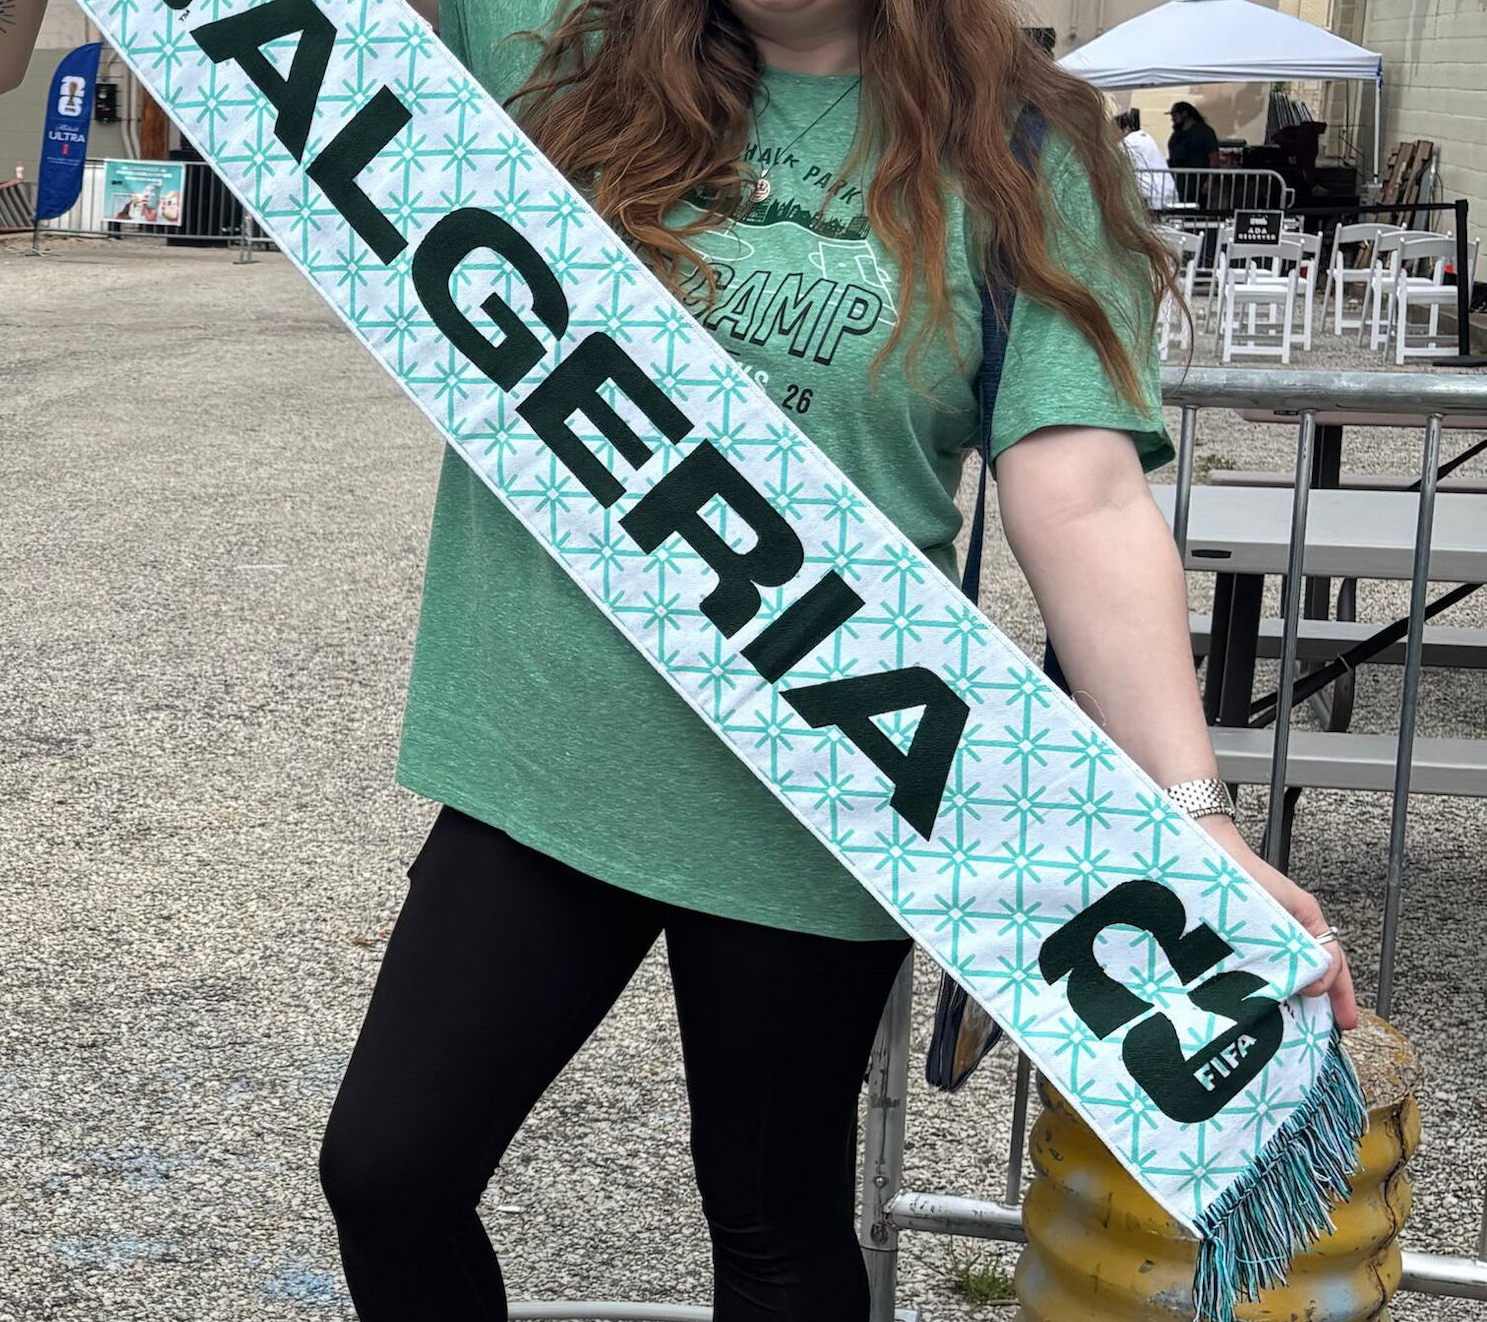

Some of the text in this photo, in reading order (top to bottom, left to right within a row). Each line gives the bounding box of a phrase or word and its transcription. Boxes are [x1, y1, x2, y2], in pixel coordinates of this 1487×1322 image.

[49, 131, 85, 142] ULTRA
[743, 142, 863, 206] HALK PARK
[781, 383, 814, 415] 26
[1192, 1033, 1258, 1092] FIFA
